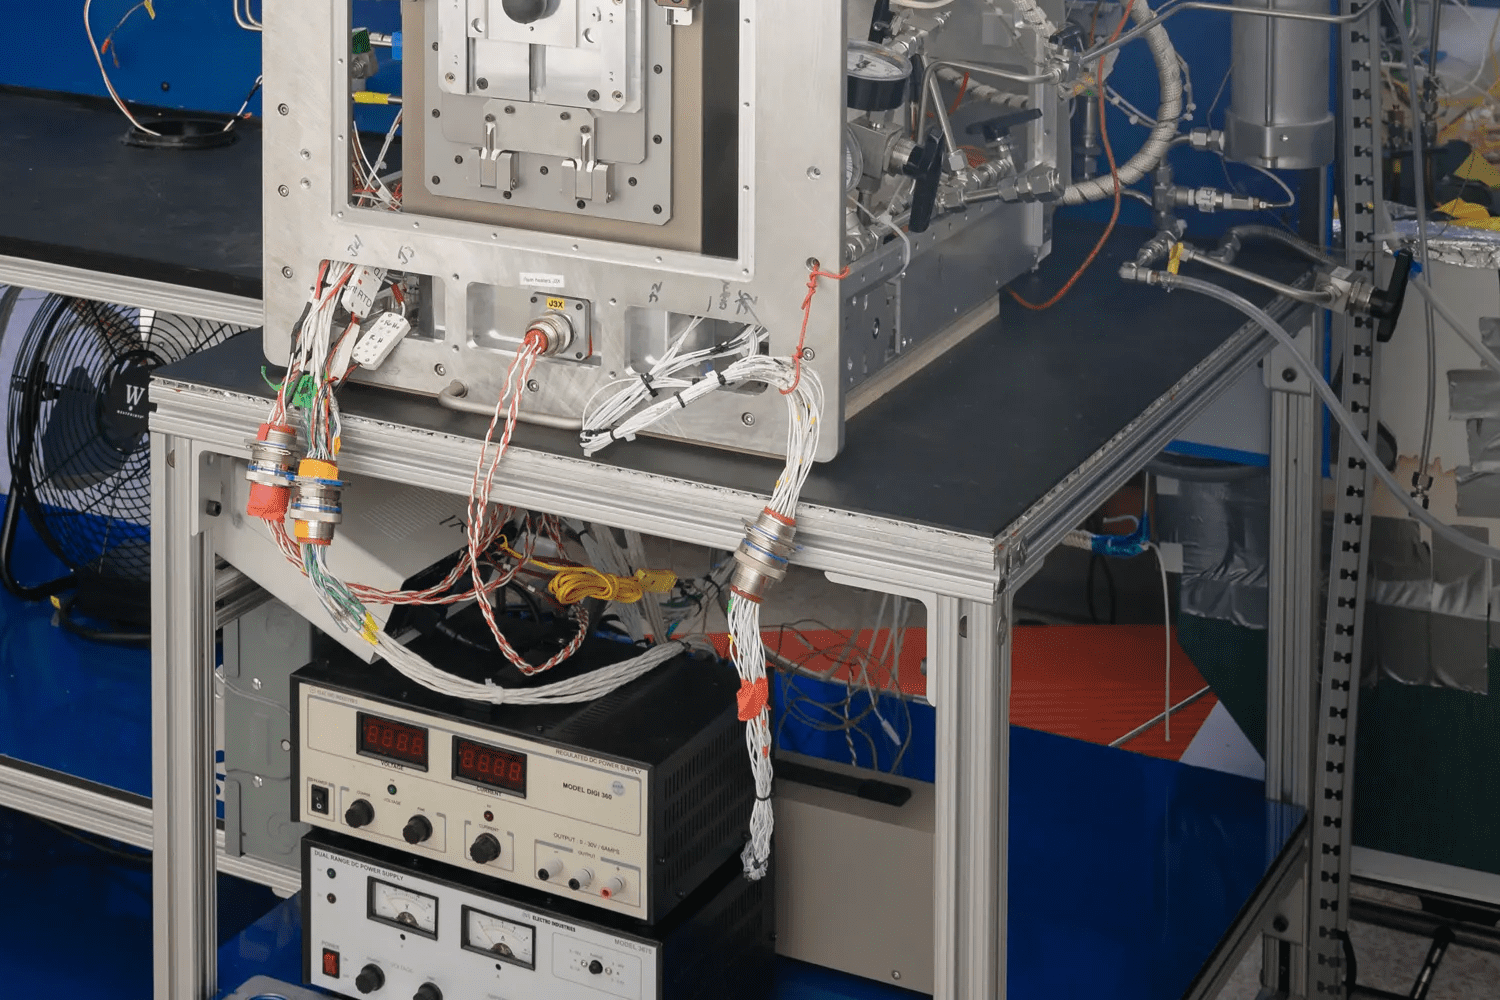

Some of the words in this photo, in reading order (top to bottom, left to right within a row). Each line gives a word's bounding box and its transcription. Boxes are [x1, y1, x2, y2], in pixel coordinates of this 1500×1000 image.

[357, 290, 372, 308] RTD
[549, 300, 563, 308] J3X
[380, 760, 404, 771] VOLTAGE
[555, 749, 588, 762] REGULATED
[598, 759, 619, 769] POWER
[620, 765, 642, 775] SUPPLY
[476, 785, 502, 797] CURRENT
[562, 782, 585, 793] MODEL
[587, 788, 600, 798] DIGI
[601, 792, 612, 801] 360
[553, 832, 575, 843] OUTPUT
[578, 850, 596, 859] OUTPUT
[314, 850, 329, 859] DUAL
[330, 854, 350, 865] RANGE
[360, 863, 381, 874] POWER
[382, 869, 404, 881] SUPPLY
[532, 916, 550, 925] ELECTRO
[552, 920, 576, 932] INDUSTRIES
[321, 940, 340, 950] POWER
[614, 939, 636, 950] MODEL
